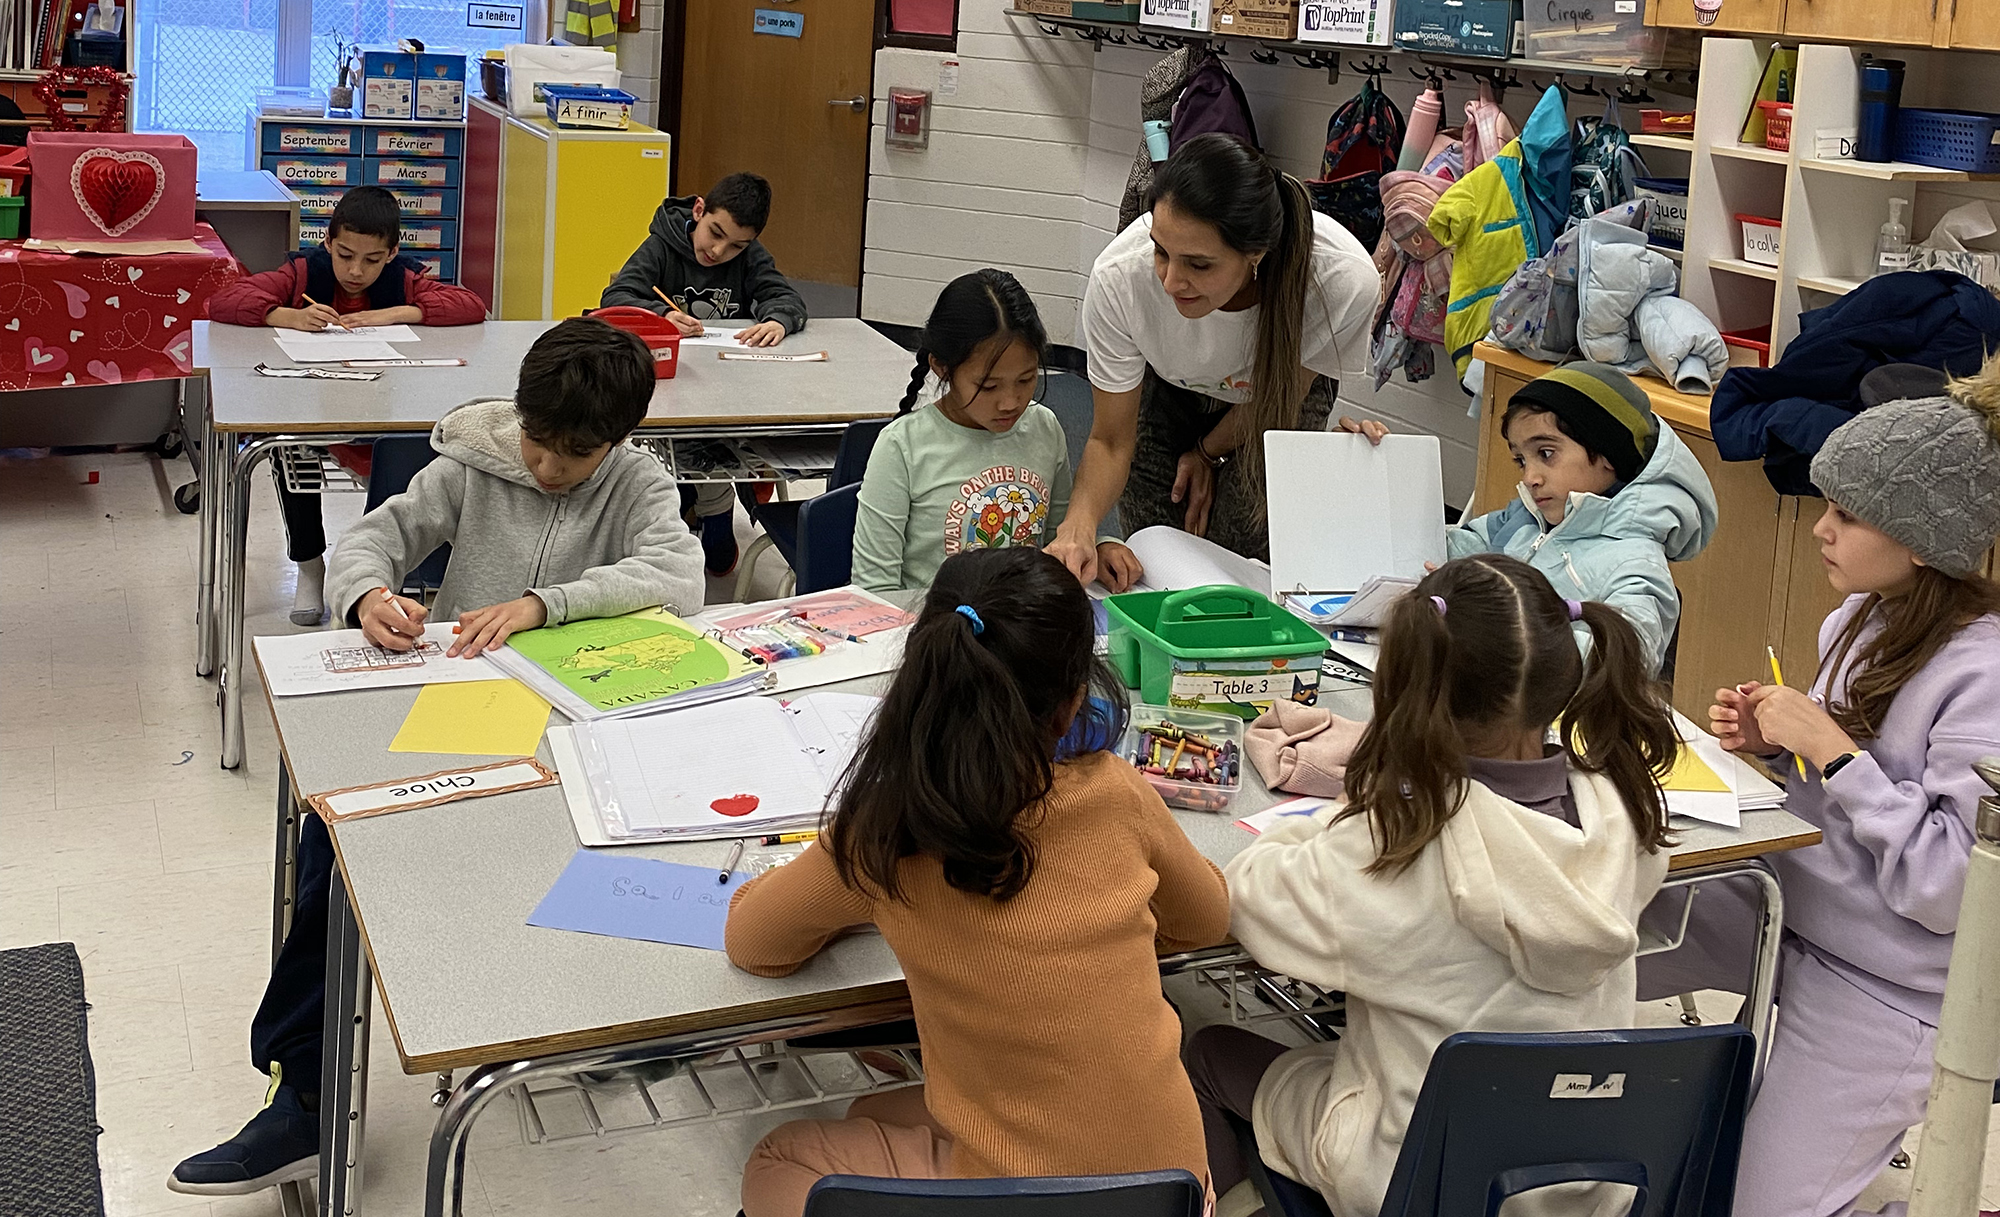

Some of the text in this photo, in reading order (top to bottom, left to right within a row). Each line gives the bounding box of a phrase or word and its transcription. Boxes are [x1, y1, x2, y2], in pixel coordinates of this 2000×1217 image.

[475, 9, 516, 22] la fenêtre
[767, 18, 796, 28] une porte
[1322, 6, 1366, 26] TopPrint
[1546, 0, 1595, 33] Cirque
[560, 100, 607, 120] À finir
[283, 134, 348, 149] Septembre
[388, 137, 433, 150] Février
[285, 166, 338, 179] Octobre
[397, 168, 428, 179] Mars
[301, 196, 340, 208] embre
[397, 197, 423, 209] Avril
[398, 230, 418, 242] Mai
[1756, 233, 1780, 254] colle
[944, 499, 968, 556] WAYS
[960, 475, 987, 501] ON
[981, 465, 1016, 486] THE
[1322, 662, 1362, 678] son
[600, 679, 698, 707] CANADA
[1212, 679, 1269, 695] Table 3
[389, 775, 476, 797] Chloe
